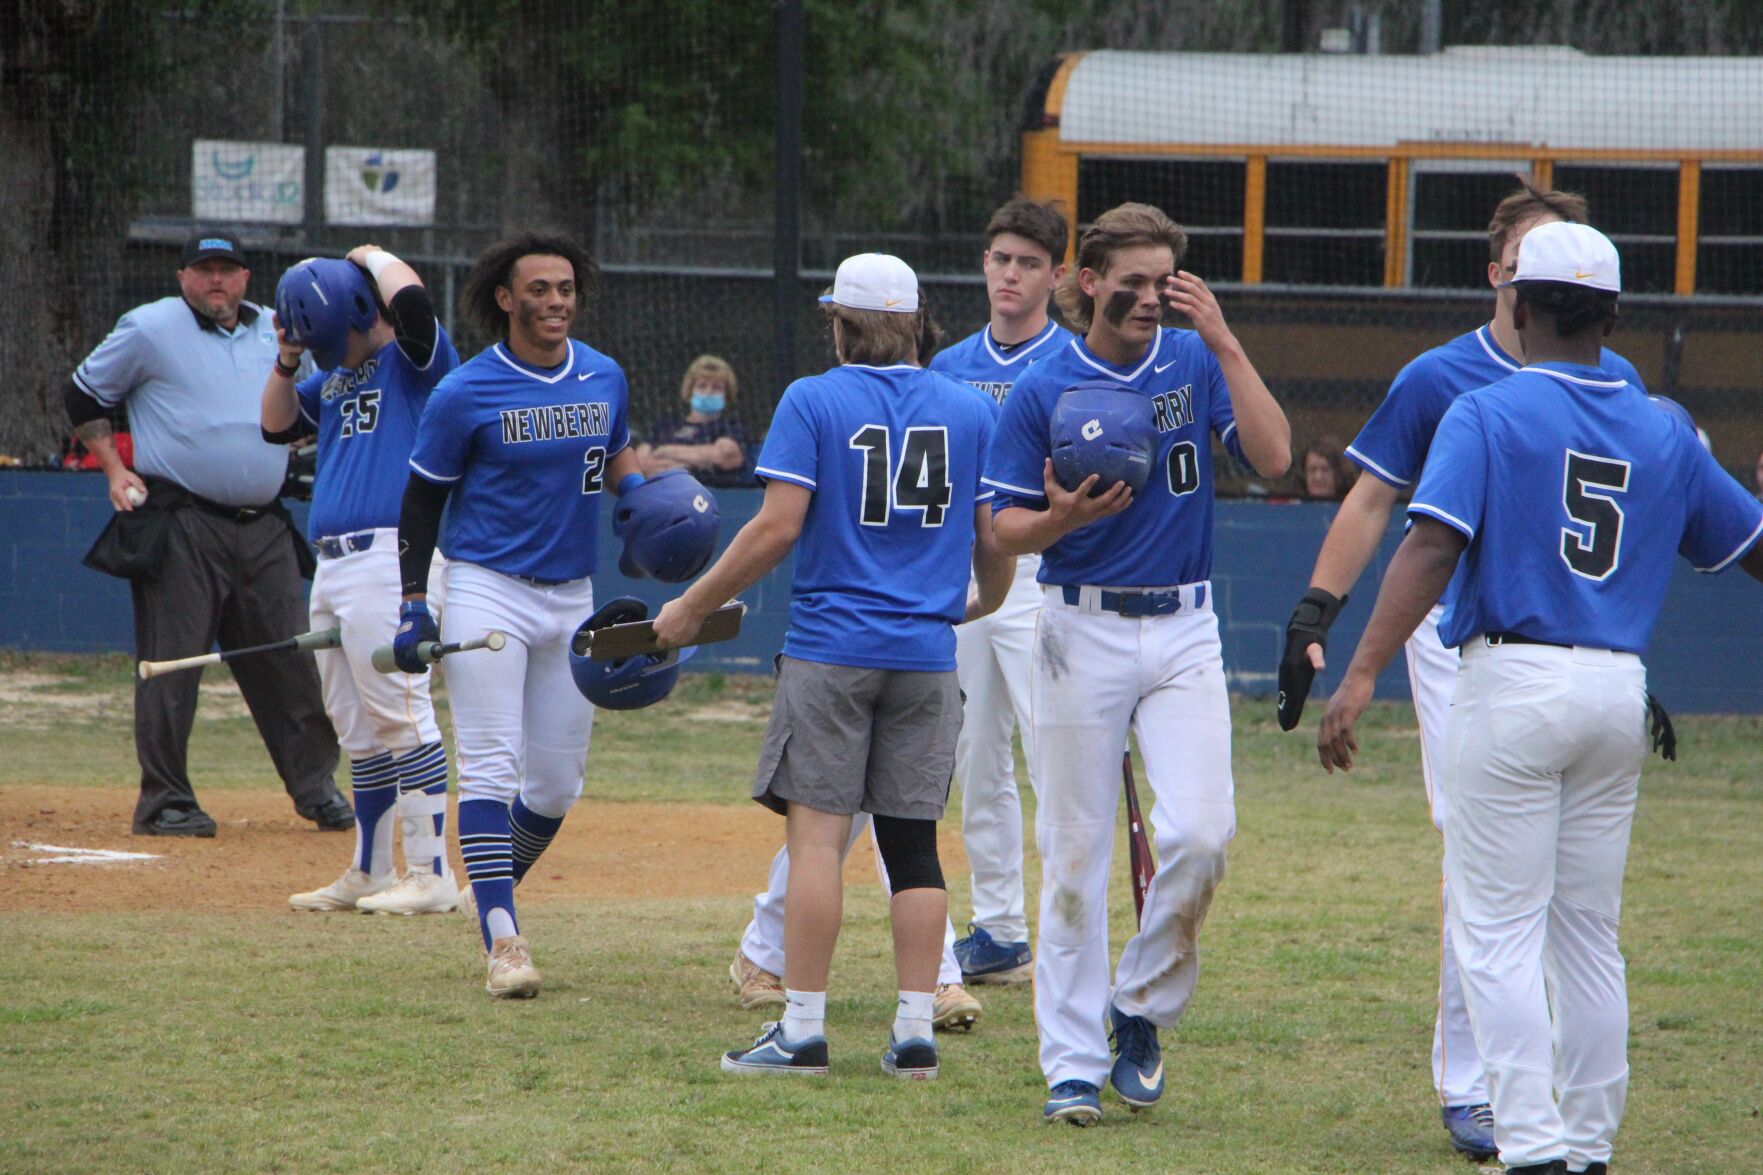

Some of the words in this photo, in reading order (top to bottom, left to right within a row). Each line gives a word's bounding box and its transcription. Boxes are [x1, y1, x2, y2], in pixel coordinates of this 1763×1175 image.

[340, 388, 382, 438] 25
[500, 402, 609, 444] NEWBERRY
[1152, 384, 1194, 433] RRY
[582, 446, 606, 495] 2
[849, 424, 953, 528] 14
[1167, 440, 1200, 497] 0
[1560, 448, 1631, 581] 5
